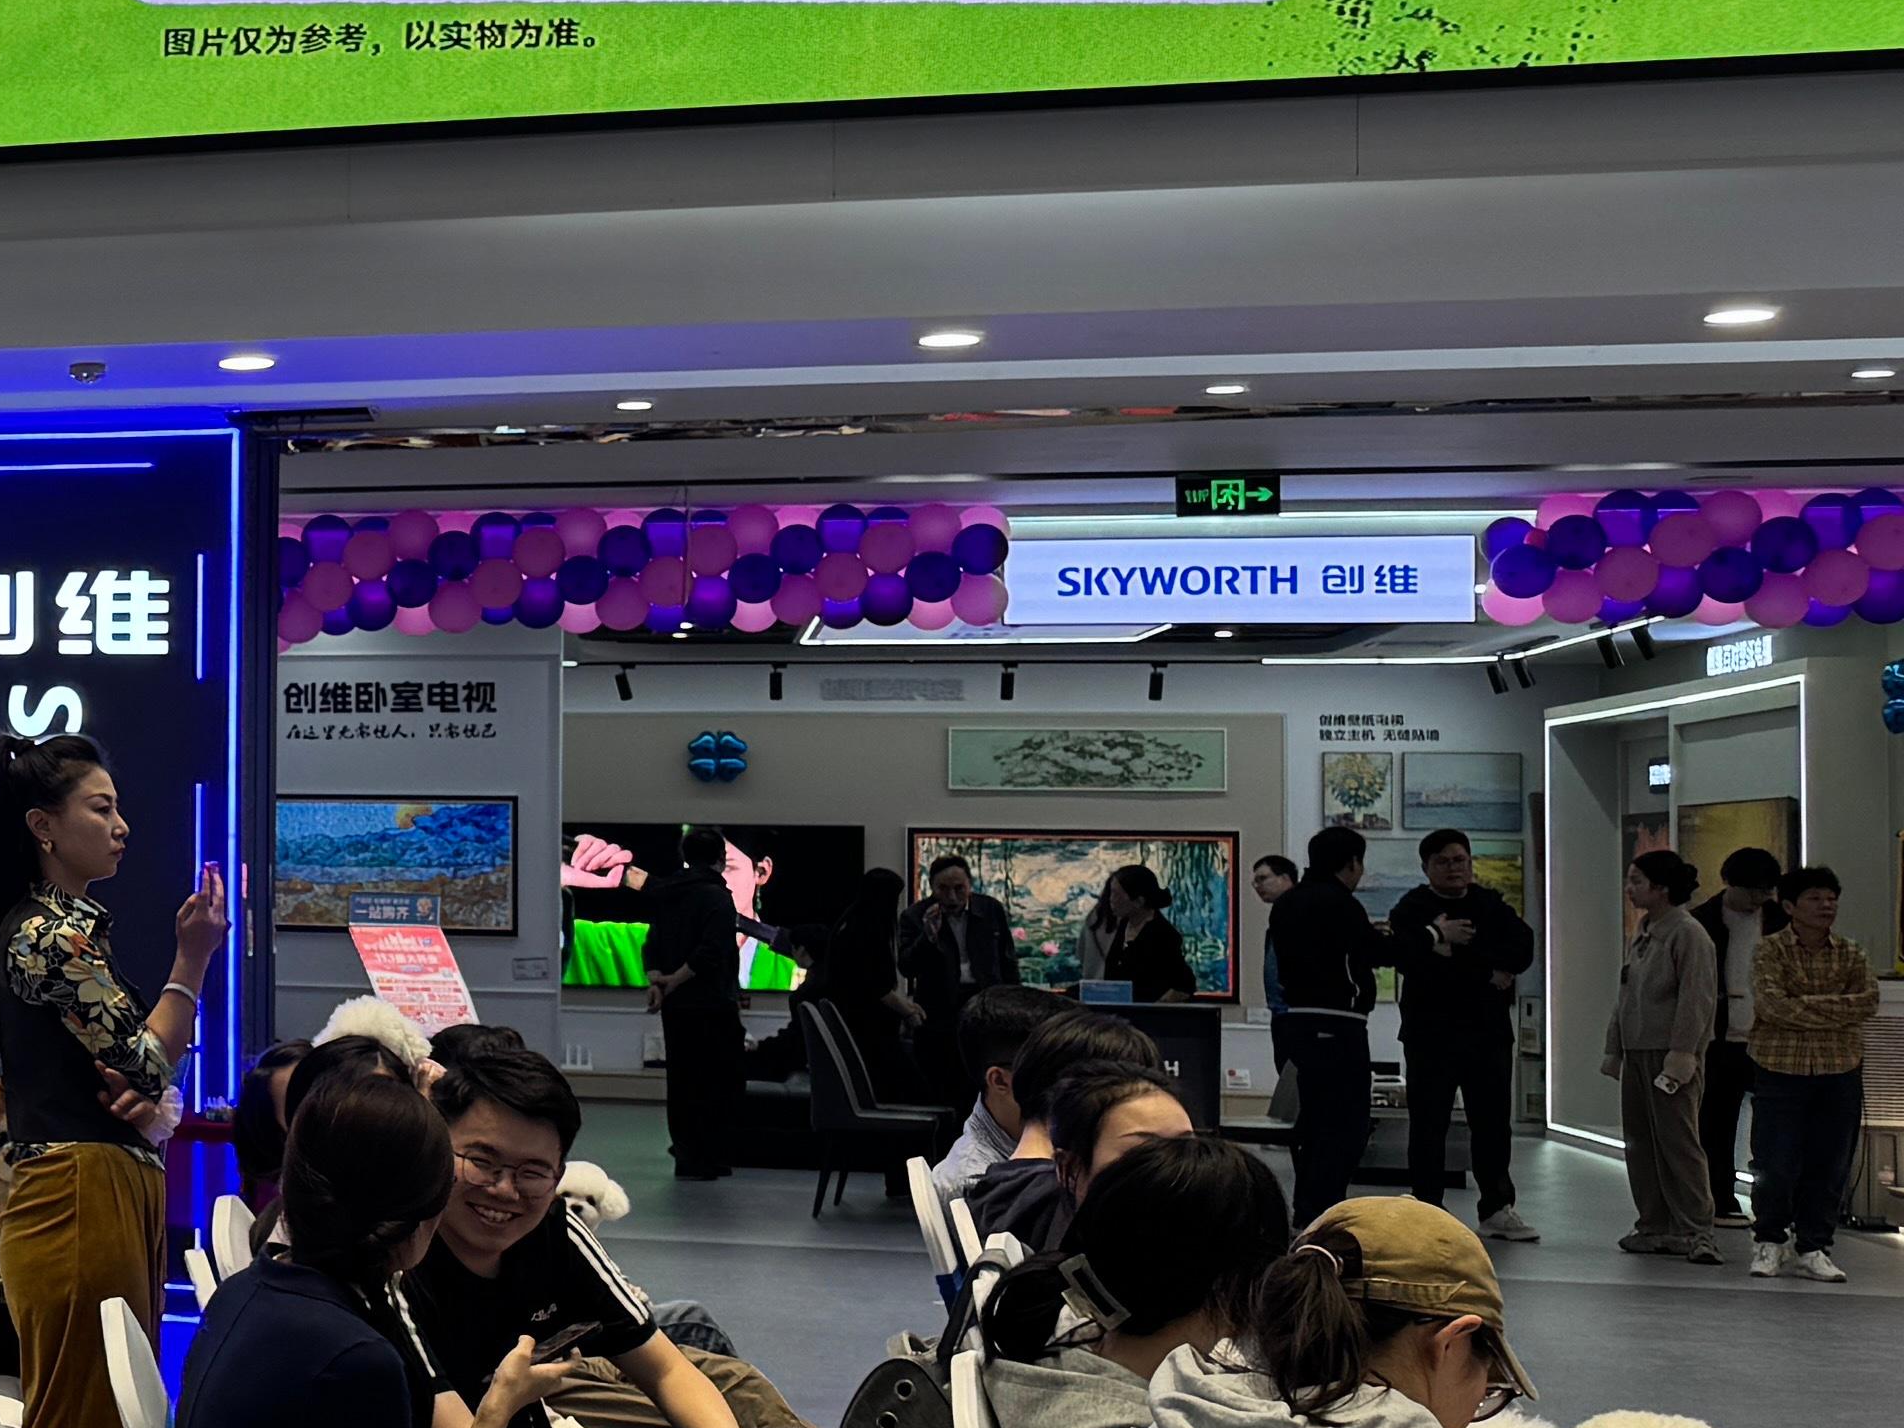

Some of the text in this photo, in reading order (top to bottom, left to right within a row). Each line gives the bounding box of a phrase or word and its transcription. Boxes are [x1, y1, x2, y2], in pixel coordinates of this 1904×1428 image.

[164, 18, 597, 60] 图片仅为参考，以实物为准。
[1057, 564, 1418, 597] SKYWORTH 创维
[283, 681, 497, 714] 创维卧室电视
